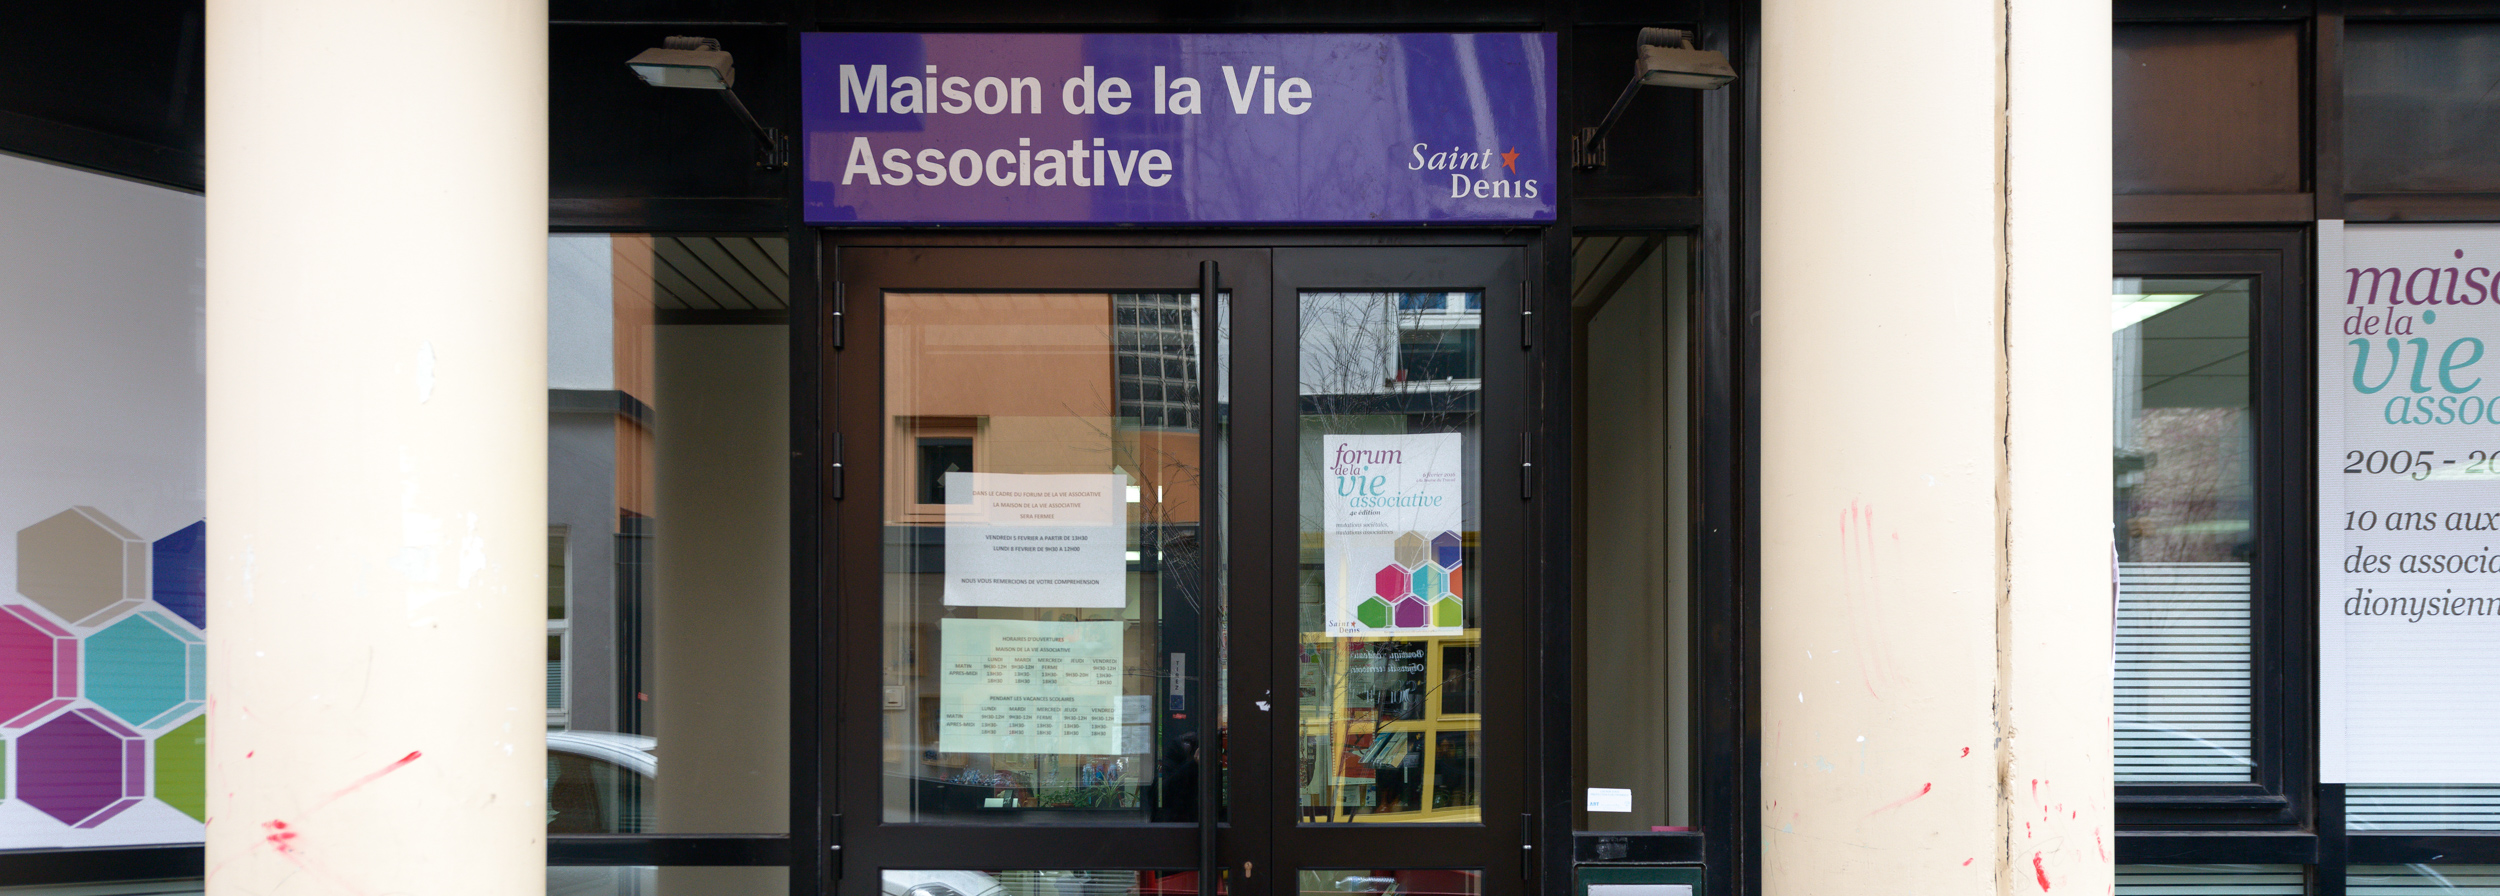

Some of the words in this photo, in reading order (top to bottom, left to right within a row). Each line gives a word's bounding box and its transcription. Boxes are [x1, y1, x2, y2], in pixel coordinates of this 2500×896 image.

[839, 64, 1041, 115] Maison
[1062, 65, 1131, 115] de
[1154, 66, 1201, 115] la
[1223, 65, 1312, 116] Vie
[842, 137, 1173, 187] Associative
[1408, 143, 1493, 171] Saint
[1451, 173, 1538, 200] Denis
[2344, 307, 2380, 335] de
[2384, 307, 2413, 335] la
[2349, 310, 2485, 394] vie
[1330, 443, 1402, 471] forum
[1335, 464, 1349, 476] de
[1350, 464, 1360, 476] la
[2343, 450, 2435, 481] 2005
[1337, 466, 1386, 497] vie
[1350, 491, 1443, 508] associative
[2344, 510, 2377, 531] 10
[2385, 510, 2437, 531] ans
[2445, 510, 2500, 531] aux
[2344, 546, 2391, 574] des
[1328, 620, 1349, 628] Saint
[1339, 626, 1360, 634] Denis
